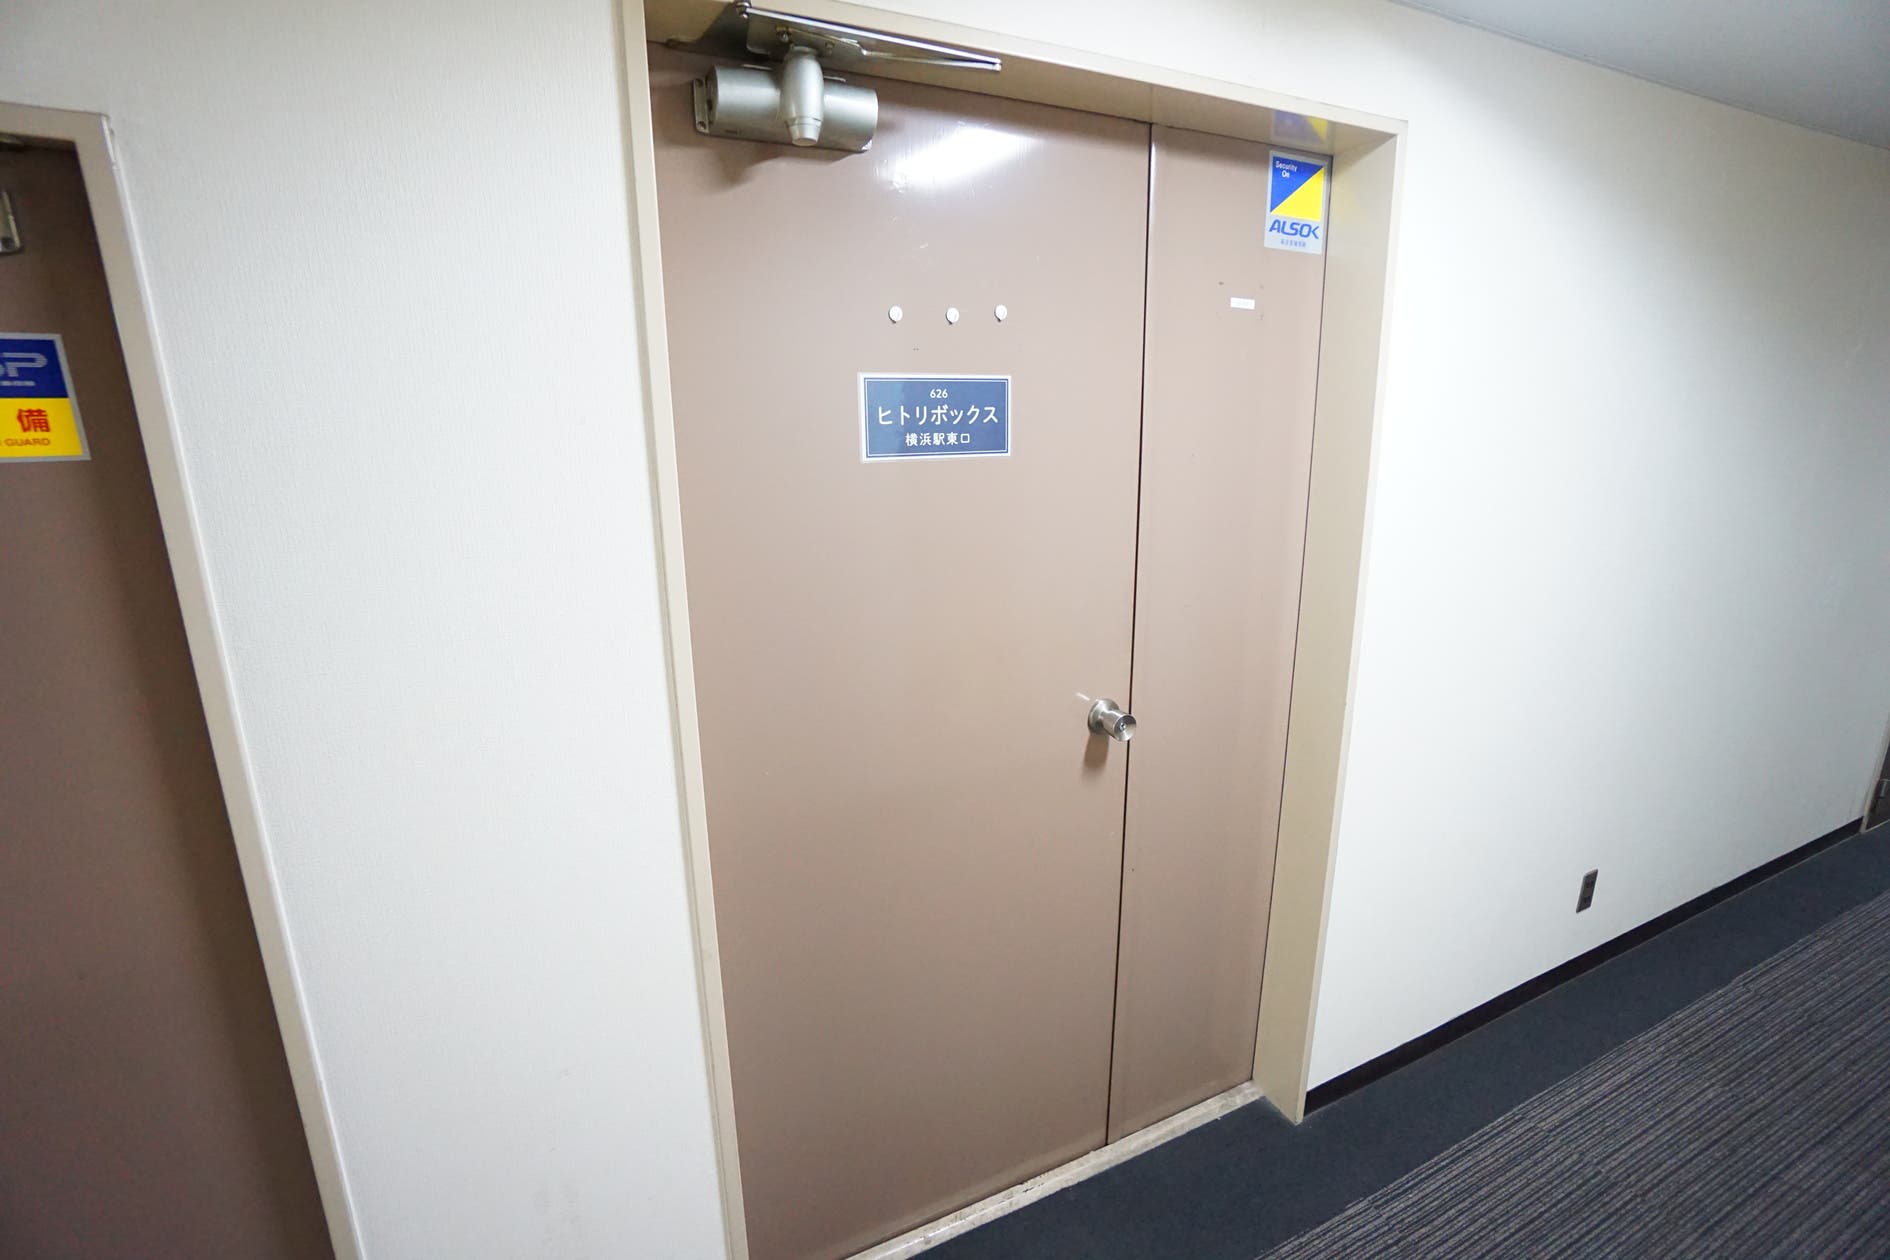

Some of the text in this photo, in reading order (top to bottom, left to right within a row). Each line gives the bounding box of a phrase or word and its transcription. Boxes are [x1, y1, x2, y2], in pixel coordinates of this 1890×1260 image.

[1275, 160, 1298, 172] Security
[1281, 170, 1290, 178] On
[1269, 219, 1319, 239] ALSOK
[929, 388, 949, 399] 626
[16, 408, 51, 432] 備
[878, 404, 998, 426] ヒトリボックス
[4, 438, 51, 447] GUARD
[905, 432, 970, 447] 横浜駅東口
